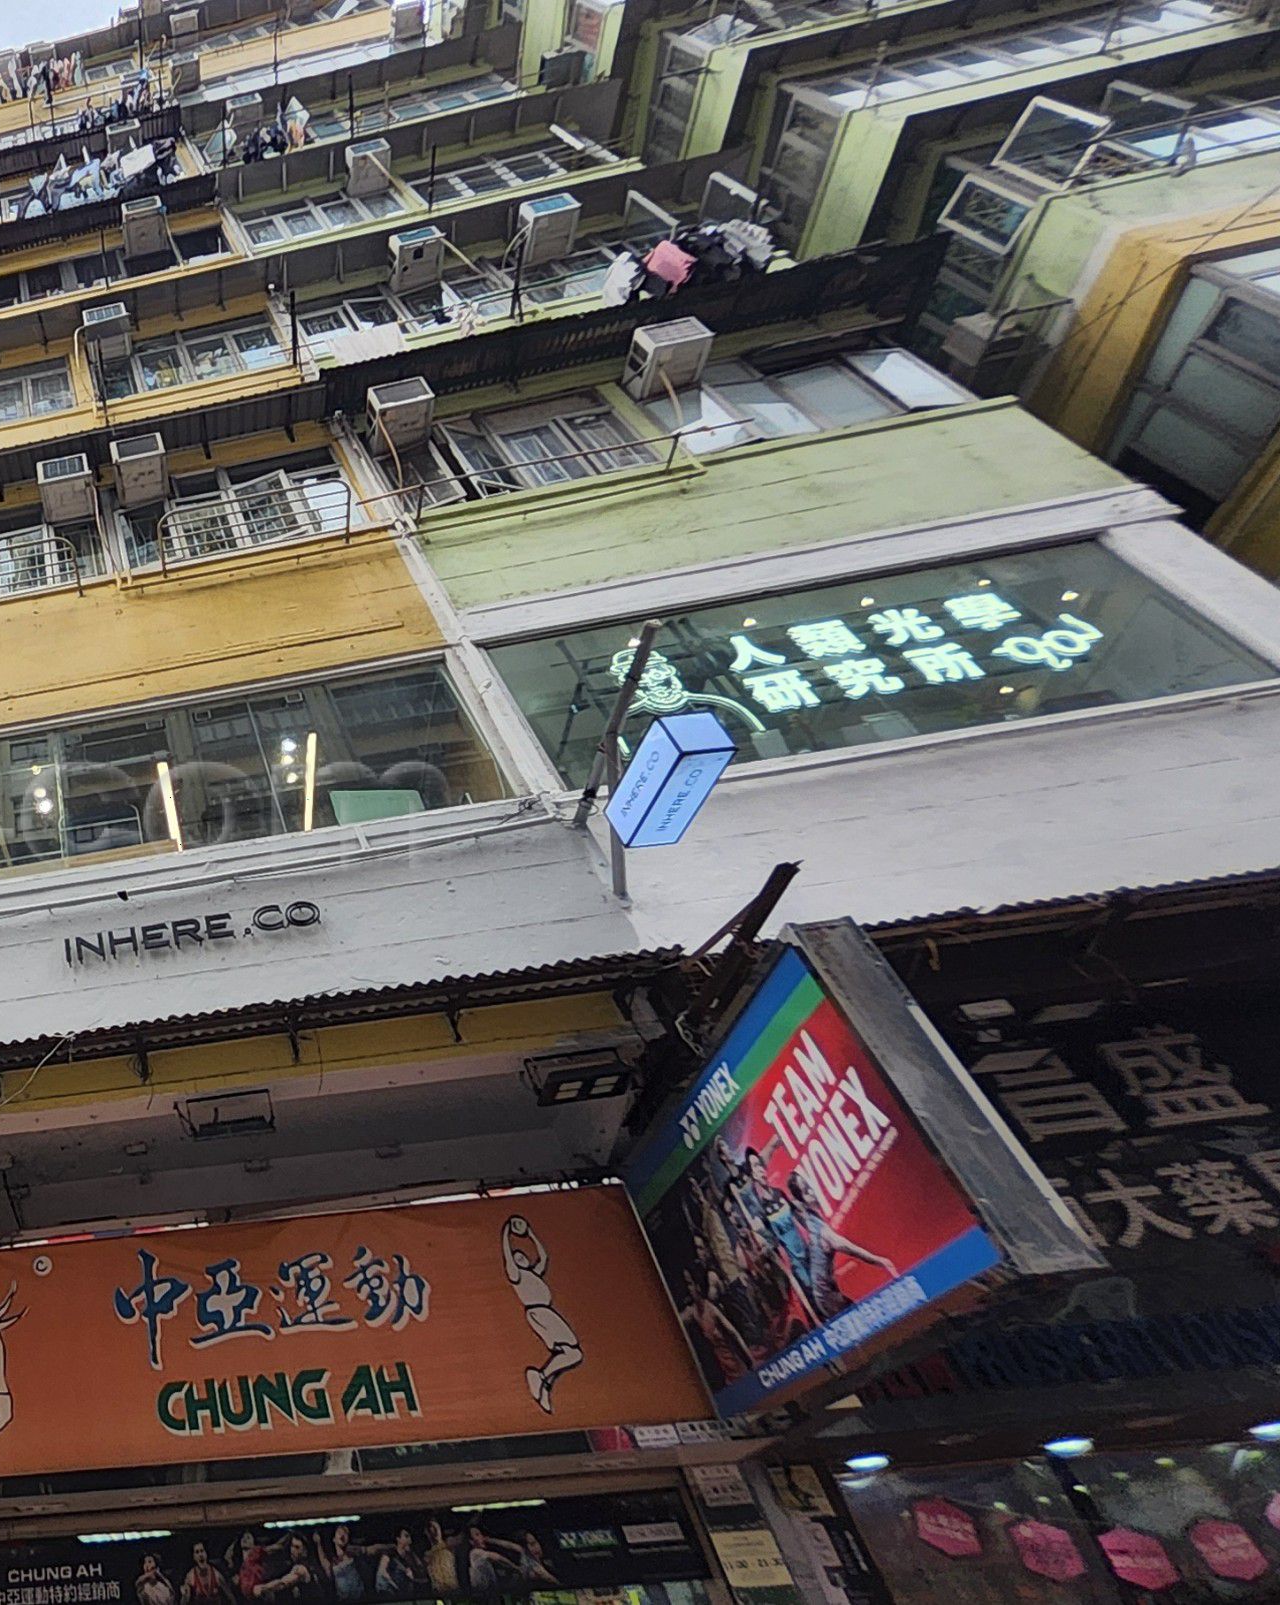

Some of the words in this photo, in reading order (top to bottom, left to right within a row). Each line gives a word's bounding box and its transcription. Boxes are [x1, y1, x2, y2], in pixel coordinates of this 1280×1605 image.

[728, 592, 1023, 673] 人類光學
[742, 642, 987, 713] 研究所
[64, 901, 322, 967] INHERE.CO
[694, 1061, 742, 1125] YONEX
[763, 1029, 837, 1160] TEAM
[794, 1066, 891, 1220] YONEX
[114, 1245, 431, 1371] 中亞運動
[157, 1367, 334, 1436] CHUNG
[341, 1361, 423, 1419] AH
[758, 1351, 808, 1389] CHUNG
[800, 1336, 828, 1363] AH
[7, 1565, 73, 1583] CHUNG
[75, 1562, 103, 1578] AH
